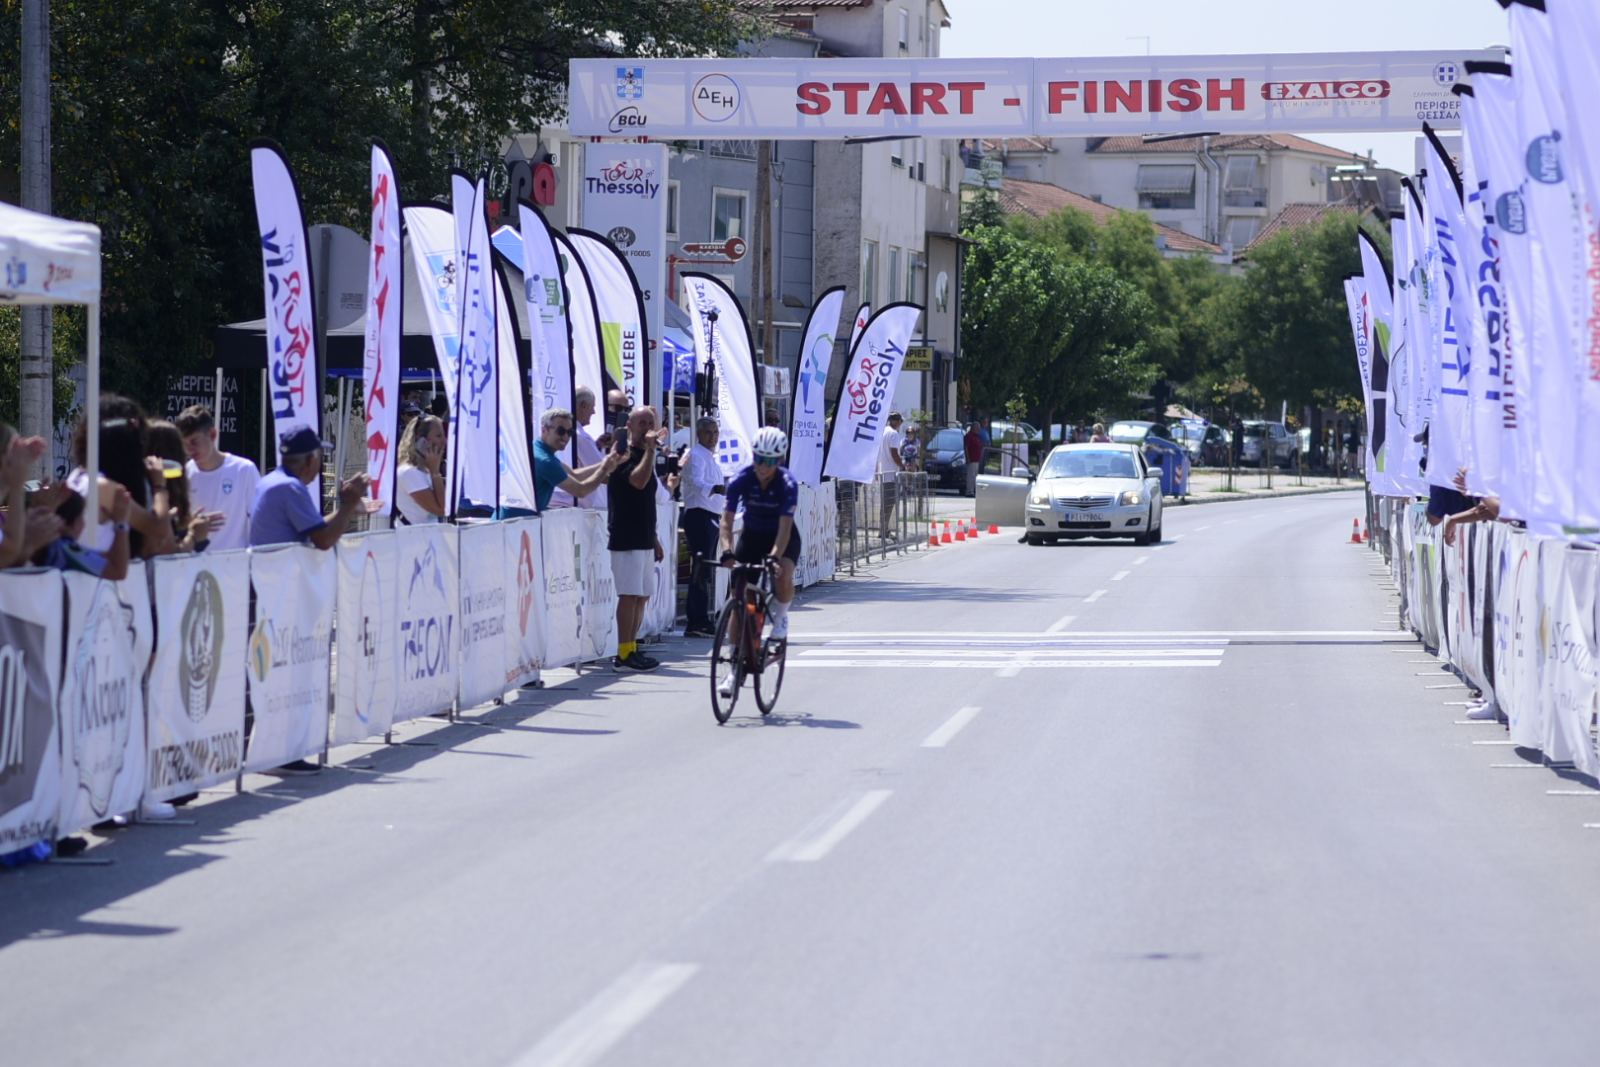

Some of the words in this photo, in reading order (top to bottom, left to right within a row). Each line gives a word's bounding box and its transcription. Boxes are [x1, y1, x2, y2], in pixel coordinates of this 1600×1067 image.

[698, 87, 733, 108] ΔΕΗ
[796, 81, 986, 116] START
[1048, 77, 1246, 115] FINISH
[1269, 82, 1384, 99] EXALCO
[1415, 101, 1461, 110] ΠΕΡΙΦΕΡ
[1417, 111, 1461, 120] ΘΕΣΣΑΛ
[618, 115, 647, 126] BCU
[601, 162, 644, 182] TOUR
[585, 177, 660, 199] Thessaly
[847, 357, 879, 421] TOUR
[853, 338, 904, 443] Thessaly
